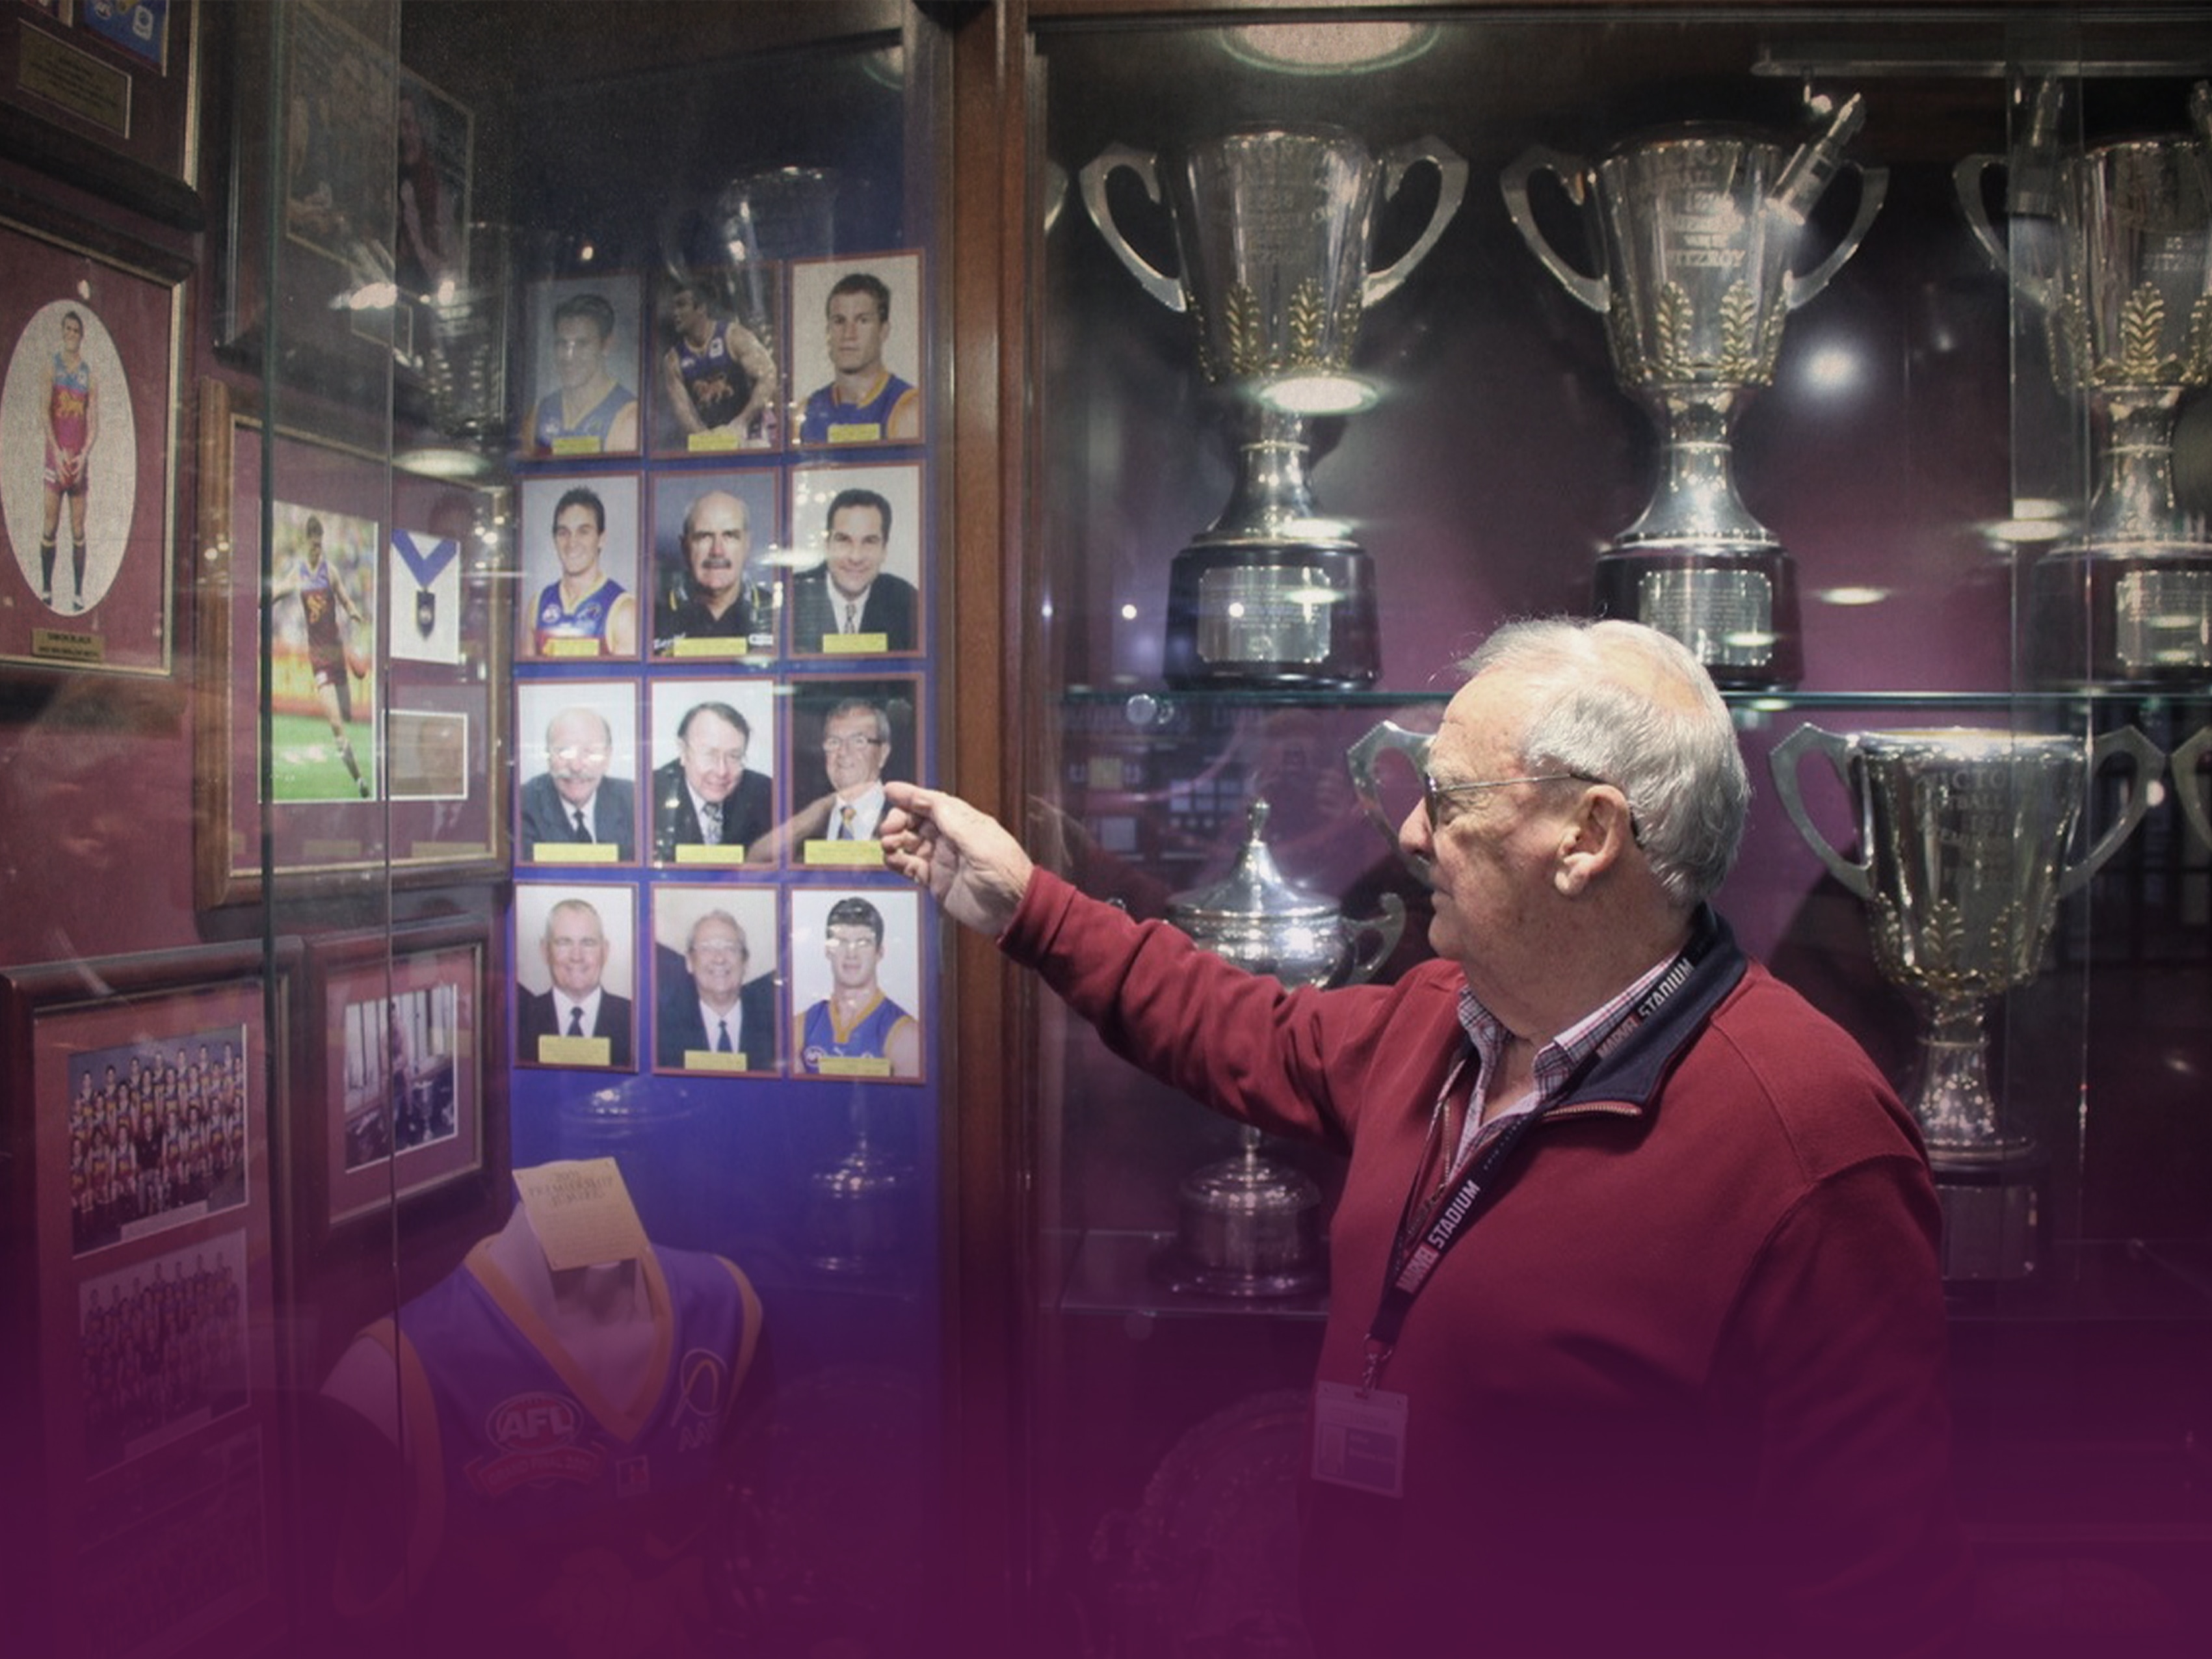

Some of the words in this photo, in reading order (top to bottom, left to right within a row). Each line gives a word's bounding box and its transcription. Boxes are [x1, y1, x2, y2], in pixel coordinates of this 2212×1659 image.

[1638, 957, 1694, 1017] STADIUM
[1427, 1178, 1481, 1250] STADIUM
[497, 1406, 575, 1442] AFL
